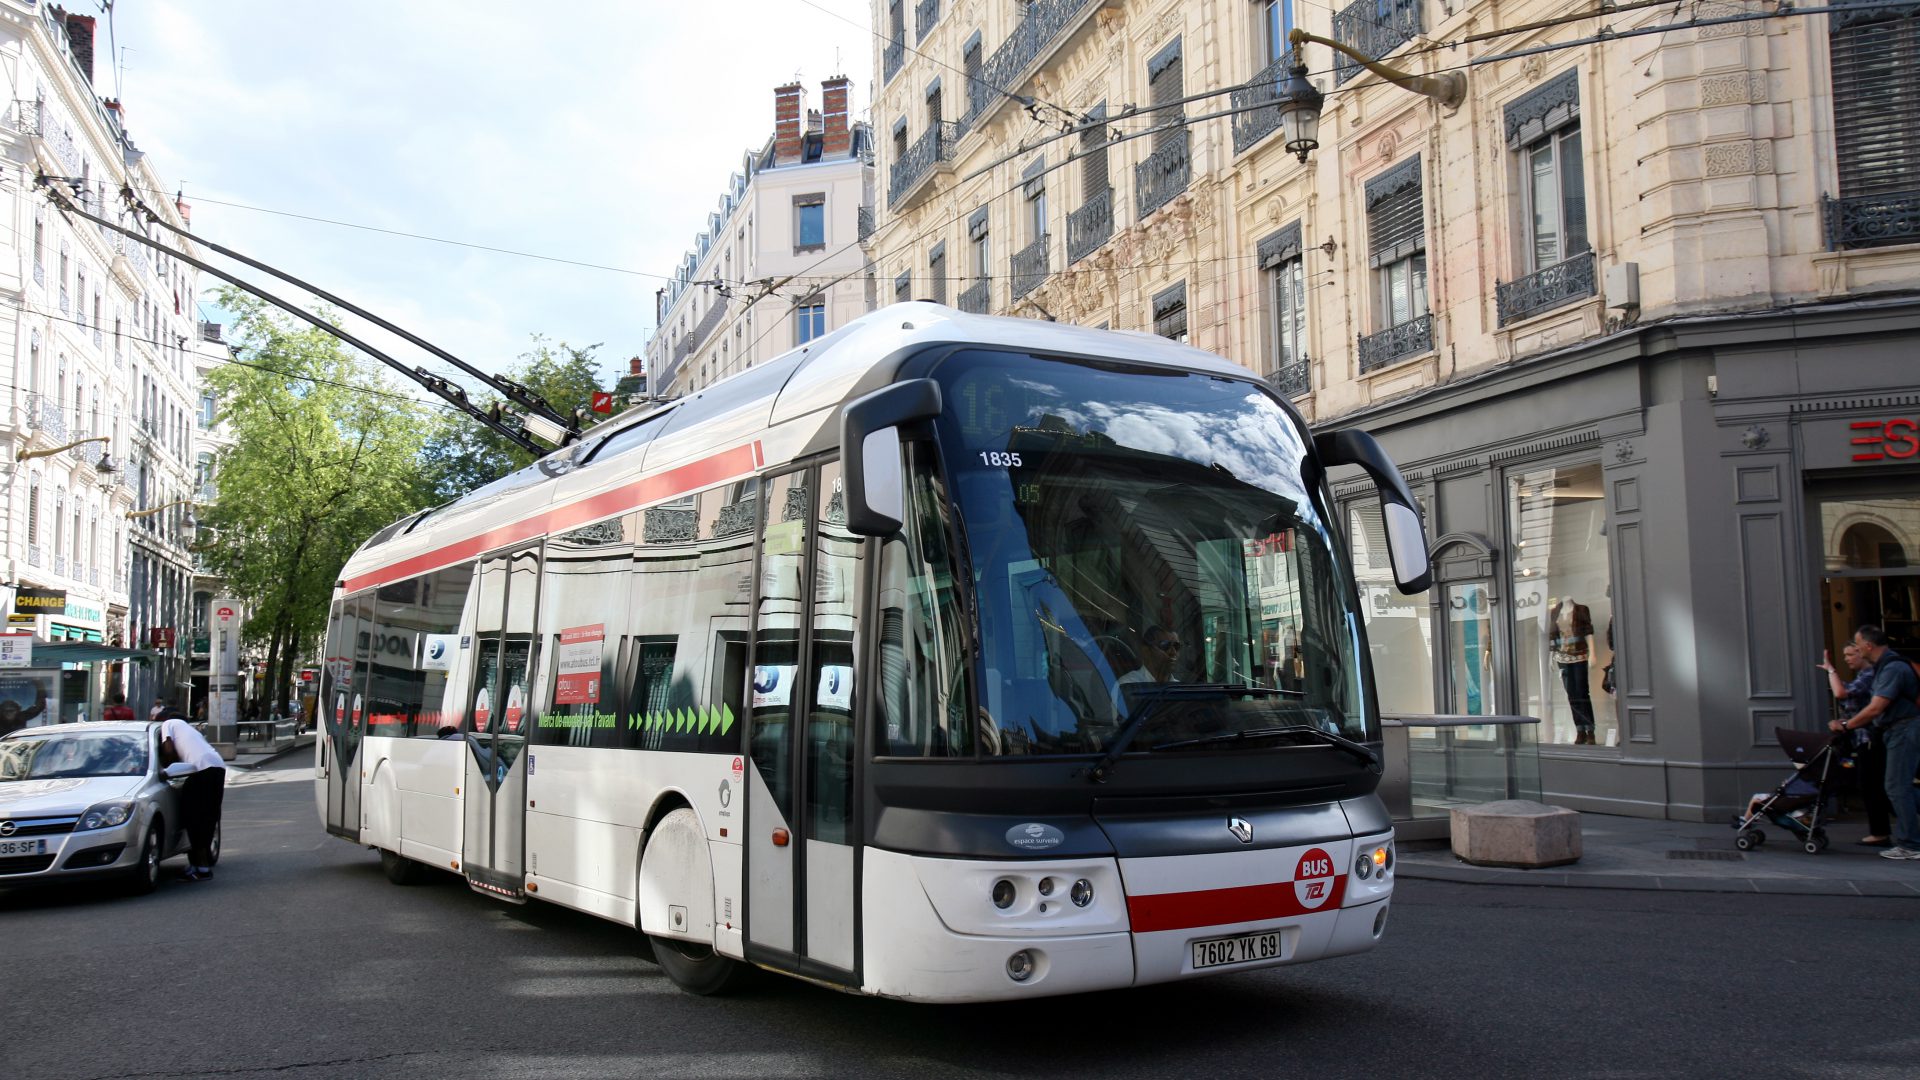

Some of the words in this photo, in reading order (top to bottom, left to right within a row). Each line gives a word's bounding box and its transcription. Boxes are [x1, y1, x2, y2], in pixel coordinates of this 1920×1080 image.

[979, 451, 1022, 468] 1835
[832, 477, 842, 493] 18
[16, 596, 65, 608] CHANGE
[538, 711, 555, 728] Merci
[1302, 858, 1328, 877] BUS
[1200, 940, 1235, 966] 7602
[1240, 937, 1256, 960] YK
[1260, 934, 1276, 957] 69
